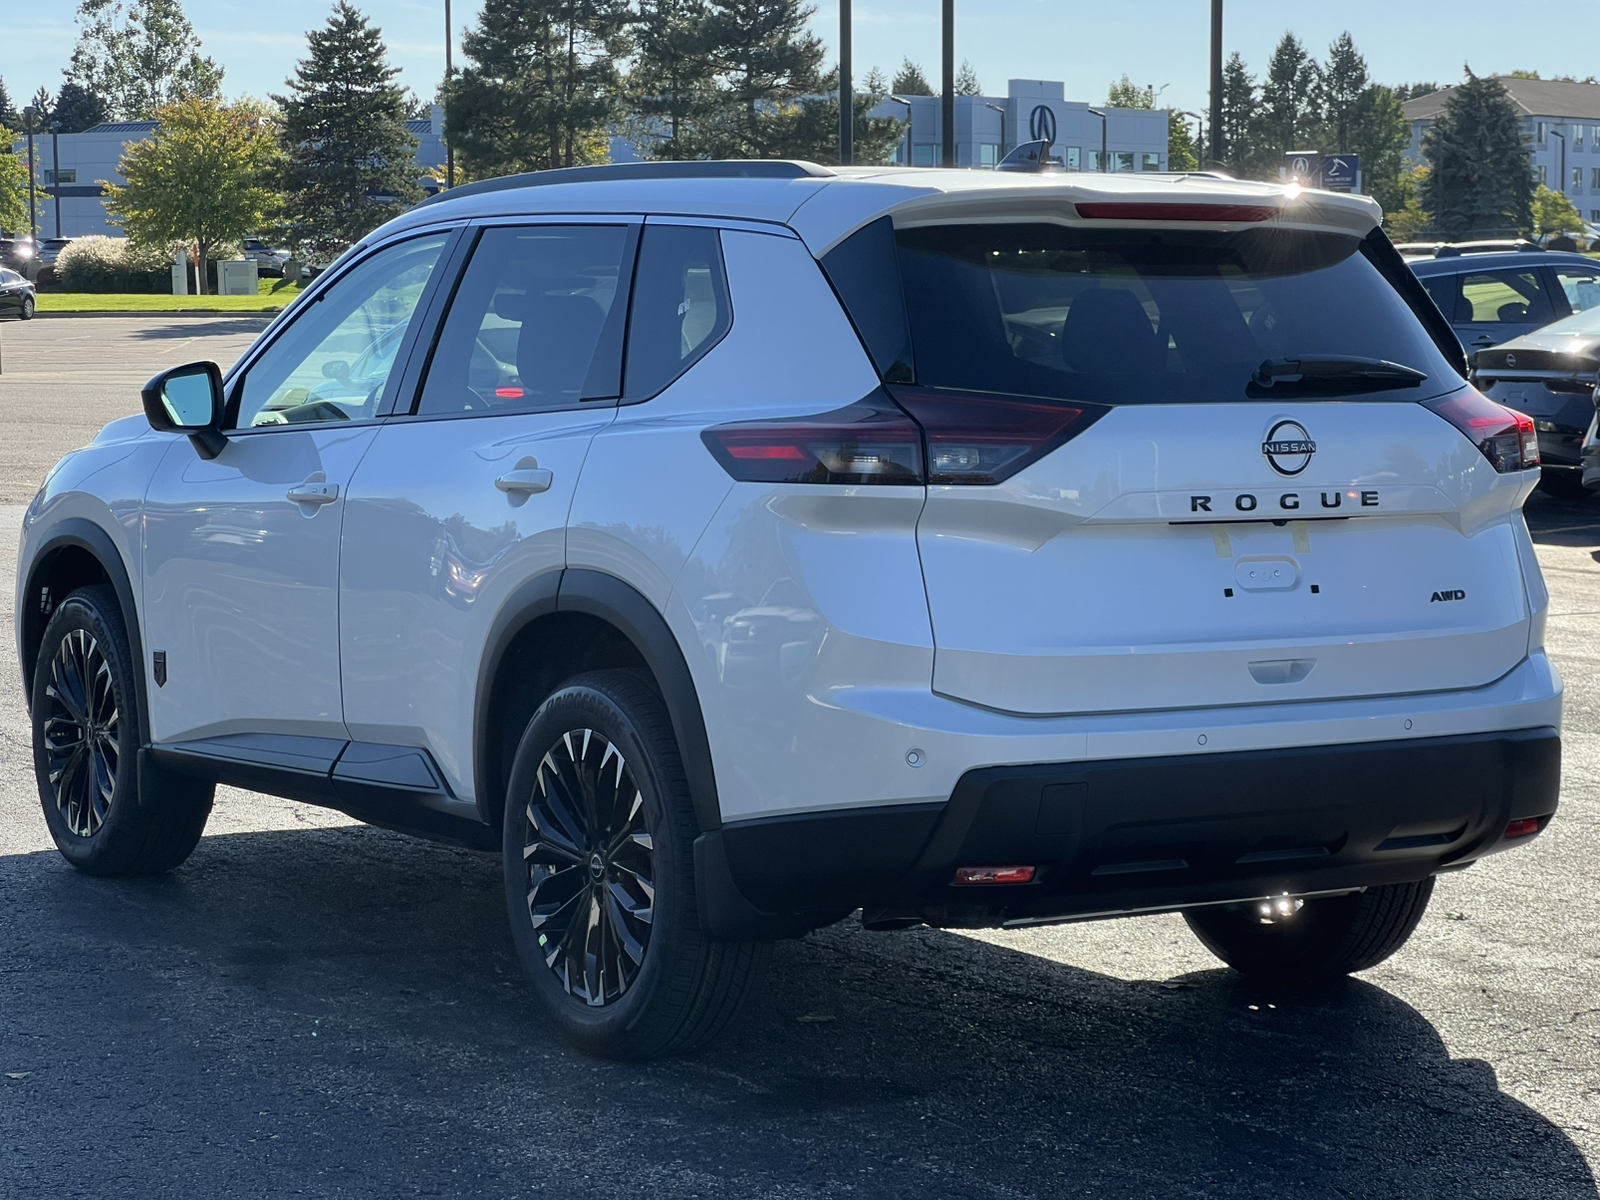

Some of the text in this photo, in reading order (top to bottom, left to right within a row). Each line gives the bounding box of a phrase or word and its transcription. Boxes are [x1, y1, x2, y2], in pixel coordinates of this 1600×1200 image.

[1263, 442, 1316, 453] NISSAN
[1190, 490, 1379, 512] ROGUE
[1430, 589, 1466, 603] AWD
